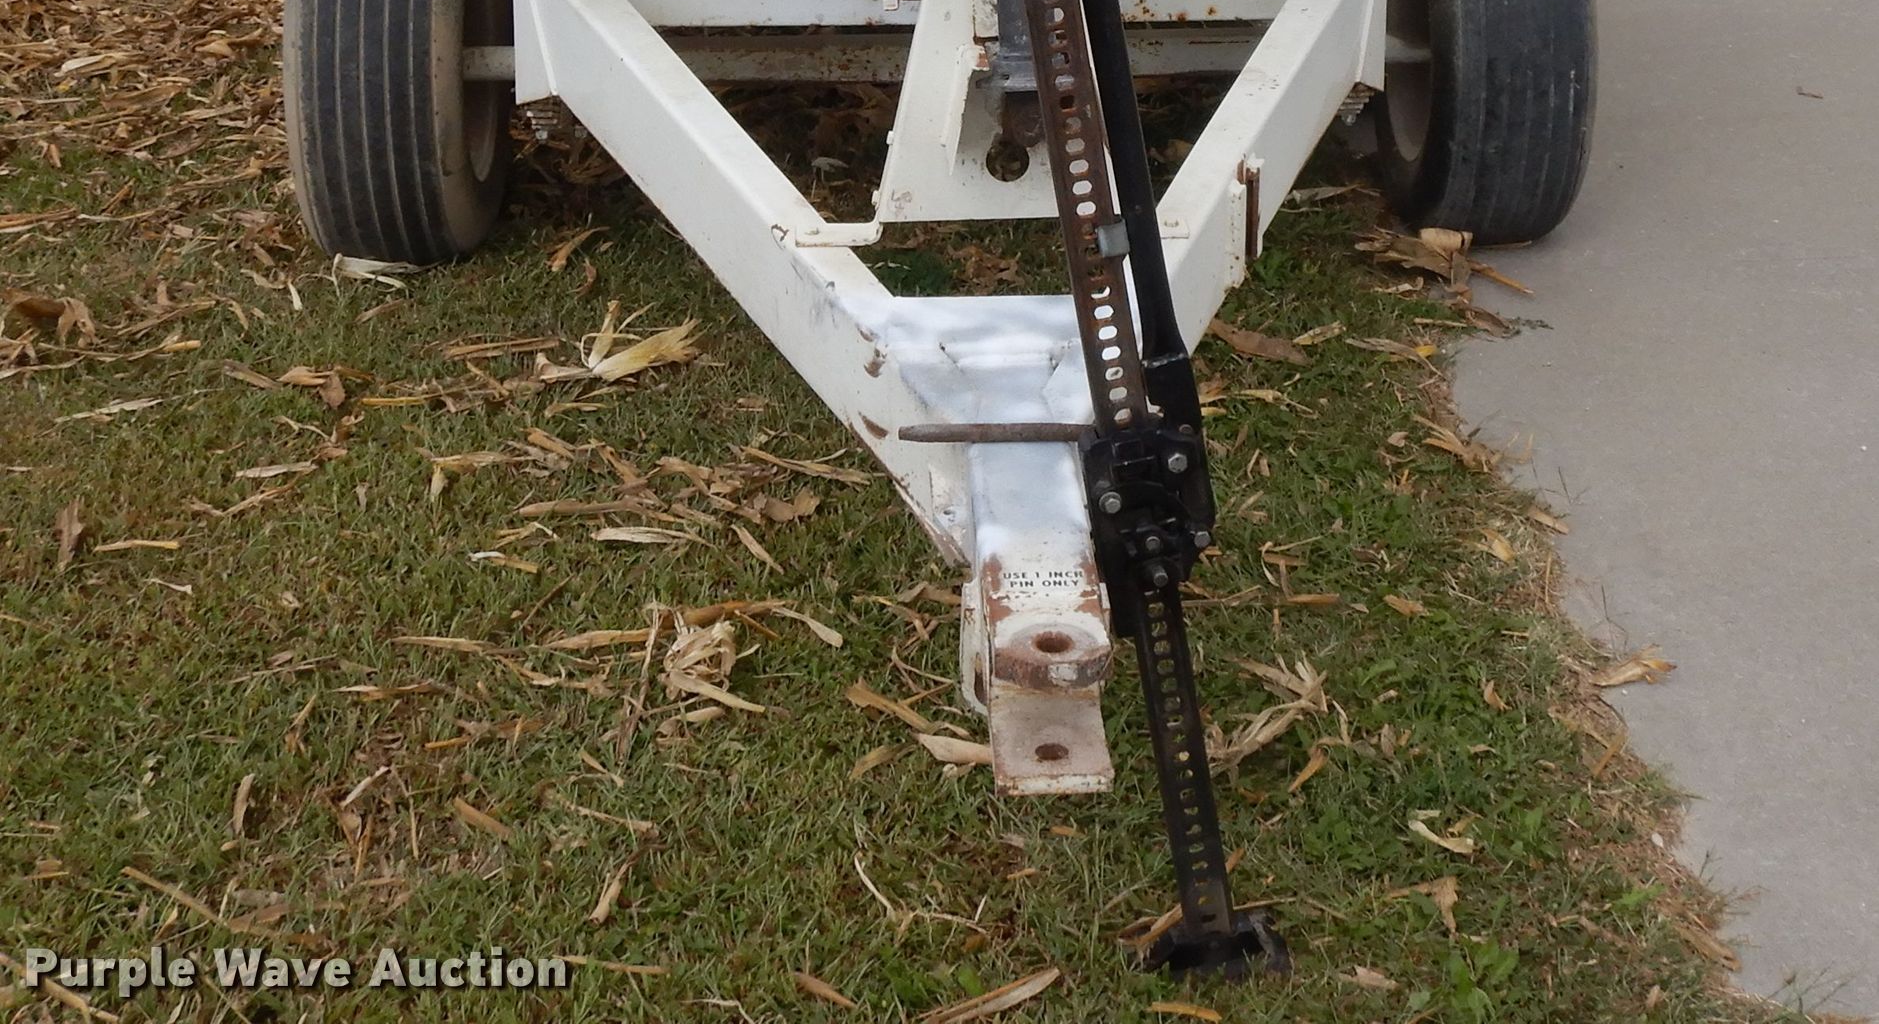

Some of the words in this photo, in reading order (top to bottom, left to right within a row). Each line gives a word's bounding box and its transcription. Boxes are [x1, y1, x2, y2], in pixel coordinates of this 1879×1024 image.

[1003, 571, 1028, 580] USE
[1034, 571, 1040, 579] 1
[1048, 571, 1084, 579] INCH
[1010, 580, 1034, 588] PIN
[1042, 579, 1079, 587] ONLY
